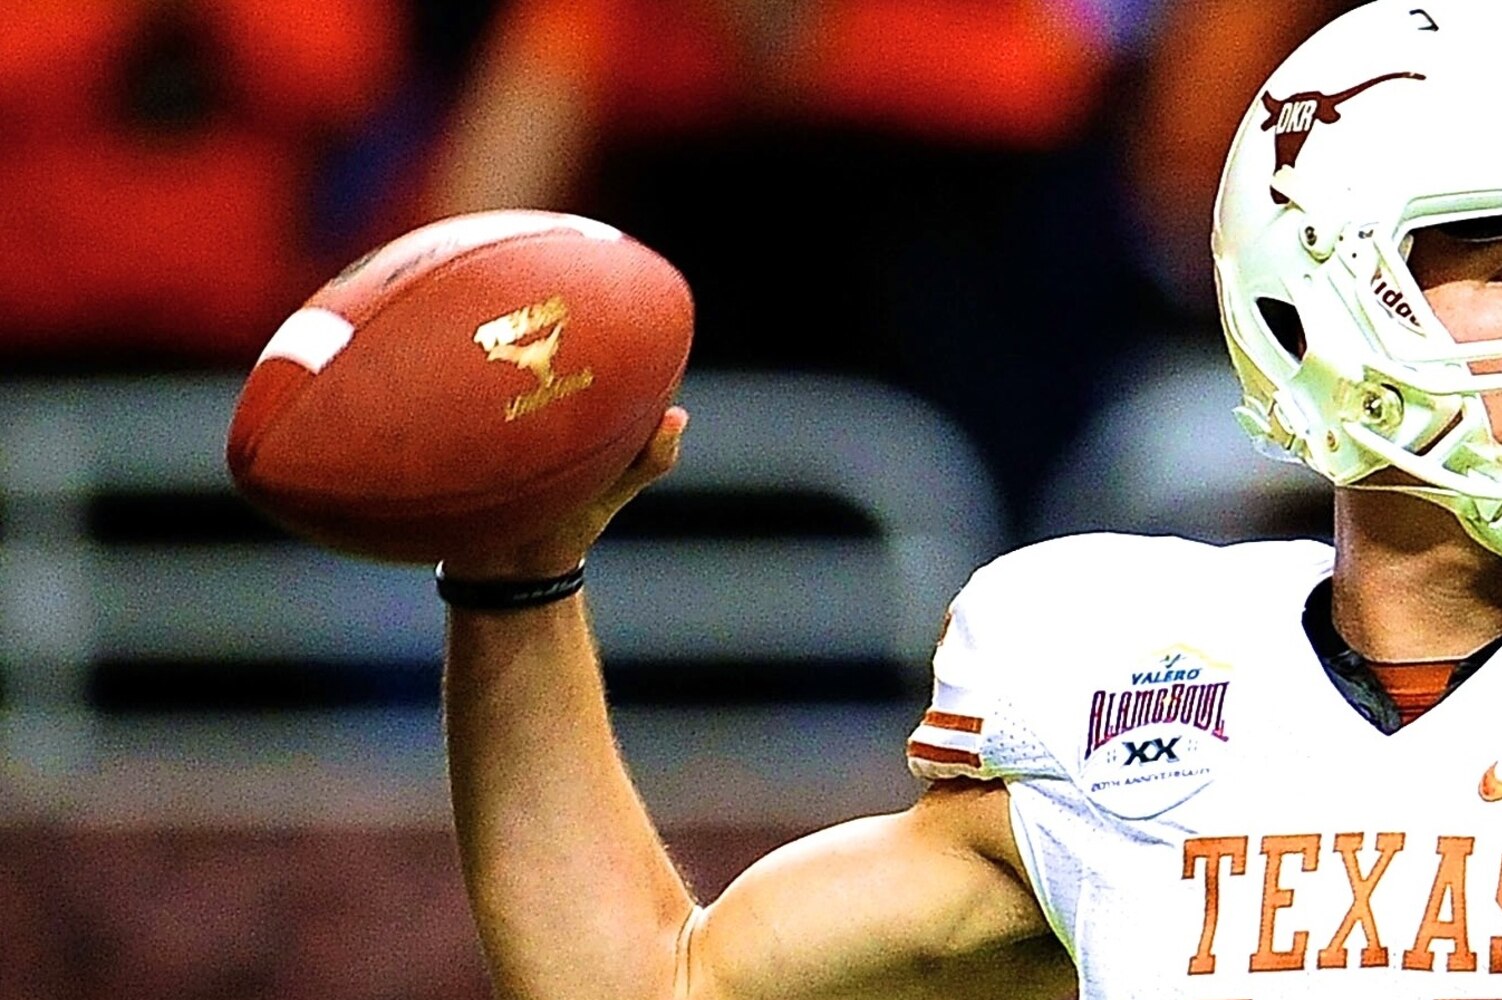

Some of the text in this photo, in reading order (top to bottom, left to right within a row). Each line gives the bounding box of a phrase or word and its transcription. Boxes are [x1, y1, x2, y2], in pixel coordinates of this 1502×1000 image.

[1276, 100, 1317, 134] DKR
[1131, 668, 1202, 686] VALERO
[1121, 735, 1182, 766] XX
